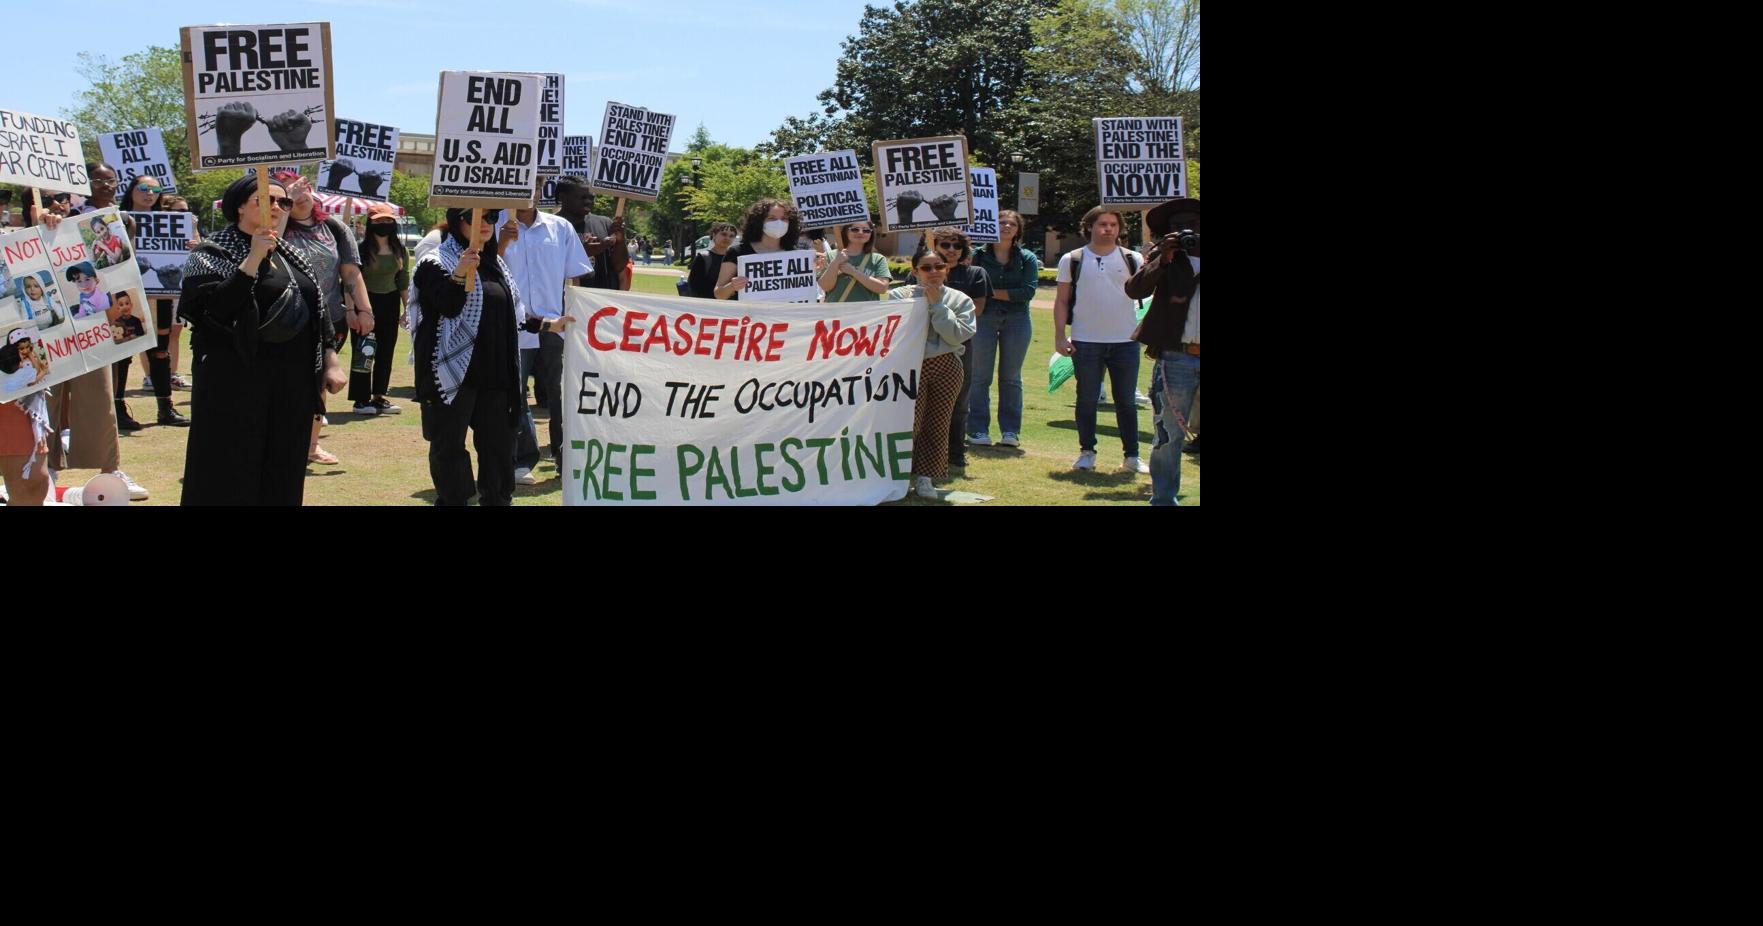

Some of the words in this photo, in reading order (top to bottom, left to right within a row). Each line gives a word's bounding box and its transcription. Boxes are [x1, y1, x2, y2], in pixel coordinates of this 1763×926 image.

[203, 28, 312, 71] FREE
[198, 68, 320, 94] PALESTINE
[467, 76, 522, 106] END
[0, 111, 75, 138] FUNDING
[467, 105, 514, 135] ALL
[609, 105, 644, 121] STAND
[647, 111, 671, 126] WITH
[1102, 120, 1142, 130] STAND
[1145, 119, 1178, 130] WITH
[335, 119, 394, 150] FREE
[608, 117, 670, 138] PALESTINE!
[1103, 131, 1178, 142] PALESTINE!
[0, 130, 68, 157] SRAELI
[113, 131, 148, 149] END
[605, 128, 637, 148] END
[641, 135, 668, 154] THE
[121, 147, 151, 164] ALL
[247, 154, 278, 162] Socialism
[336, 143, 395, 163] ALESTINE
[443, 138, 487, 164] U.S.
[492, 142, 532, 166] AID
[601, 147, 663, 167] OCCUPATION
[886, 143, 957, 173] FREE
[1103, 143, 1140, 159] END
[1145, 143, 1180, 159] THE
[0, 151, 25, 175] AR
[28, 154, 87, 185] CRIMES
[144, 163, 167, 177] AID
[439, 164, 460, 182] TO
[464, 166, 530, 186] ISRAEL!
[598, 158, 659, 189] NOW!
[790, 159, 827, 176] FREE
[830, 156, 856, 171] ALL
[1104, 163, 1181, 174] OCCUPATION
[792, 170, 858, 187] PALESTINIAN
[885, 168, 963, 187] PALESTINE
[1105, 174, 1180, 196] NOW!
[797, 190, 862, 208] POLITICAL
[800, 203, 864, 220] PRISONERS
[135, 213, 186, 238] REE
[4, 238, 43, 265] NOT
[52, 243, 87, 267] JUST
[135, 238, 190, 251] LESTINE
[745, 260, 784, 278] FREE
[787, 257, 813, 276] ALL
[745, 276, 814, 293] PALESTINIAN
[46, 323, 112, 361] NUMBERS
[578, 372, 641, 418] END
[664, 382, 725, 418] THE
